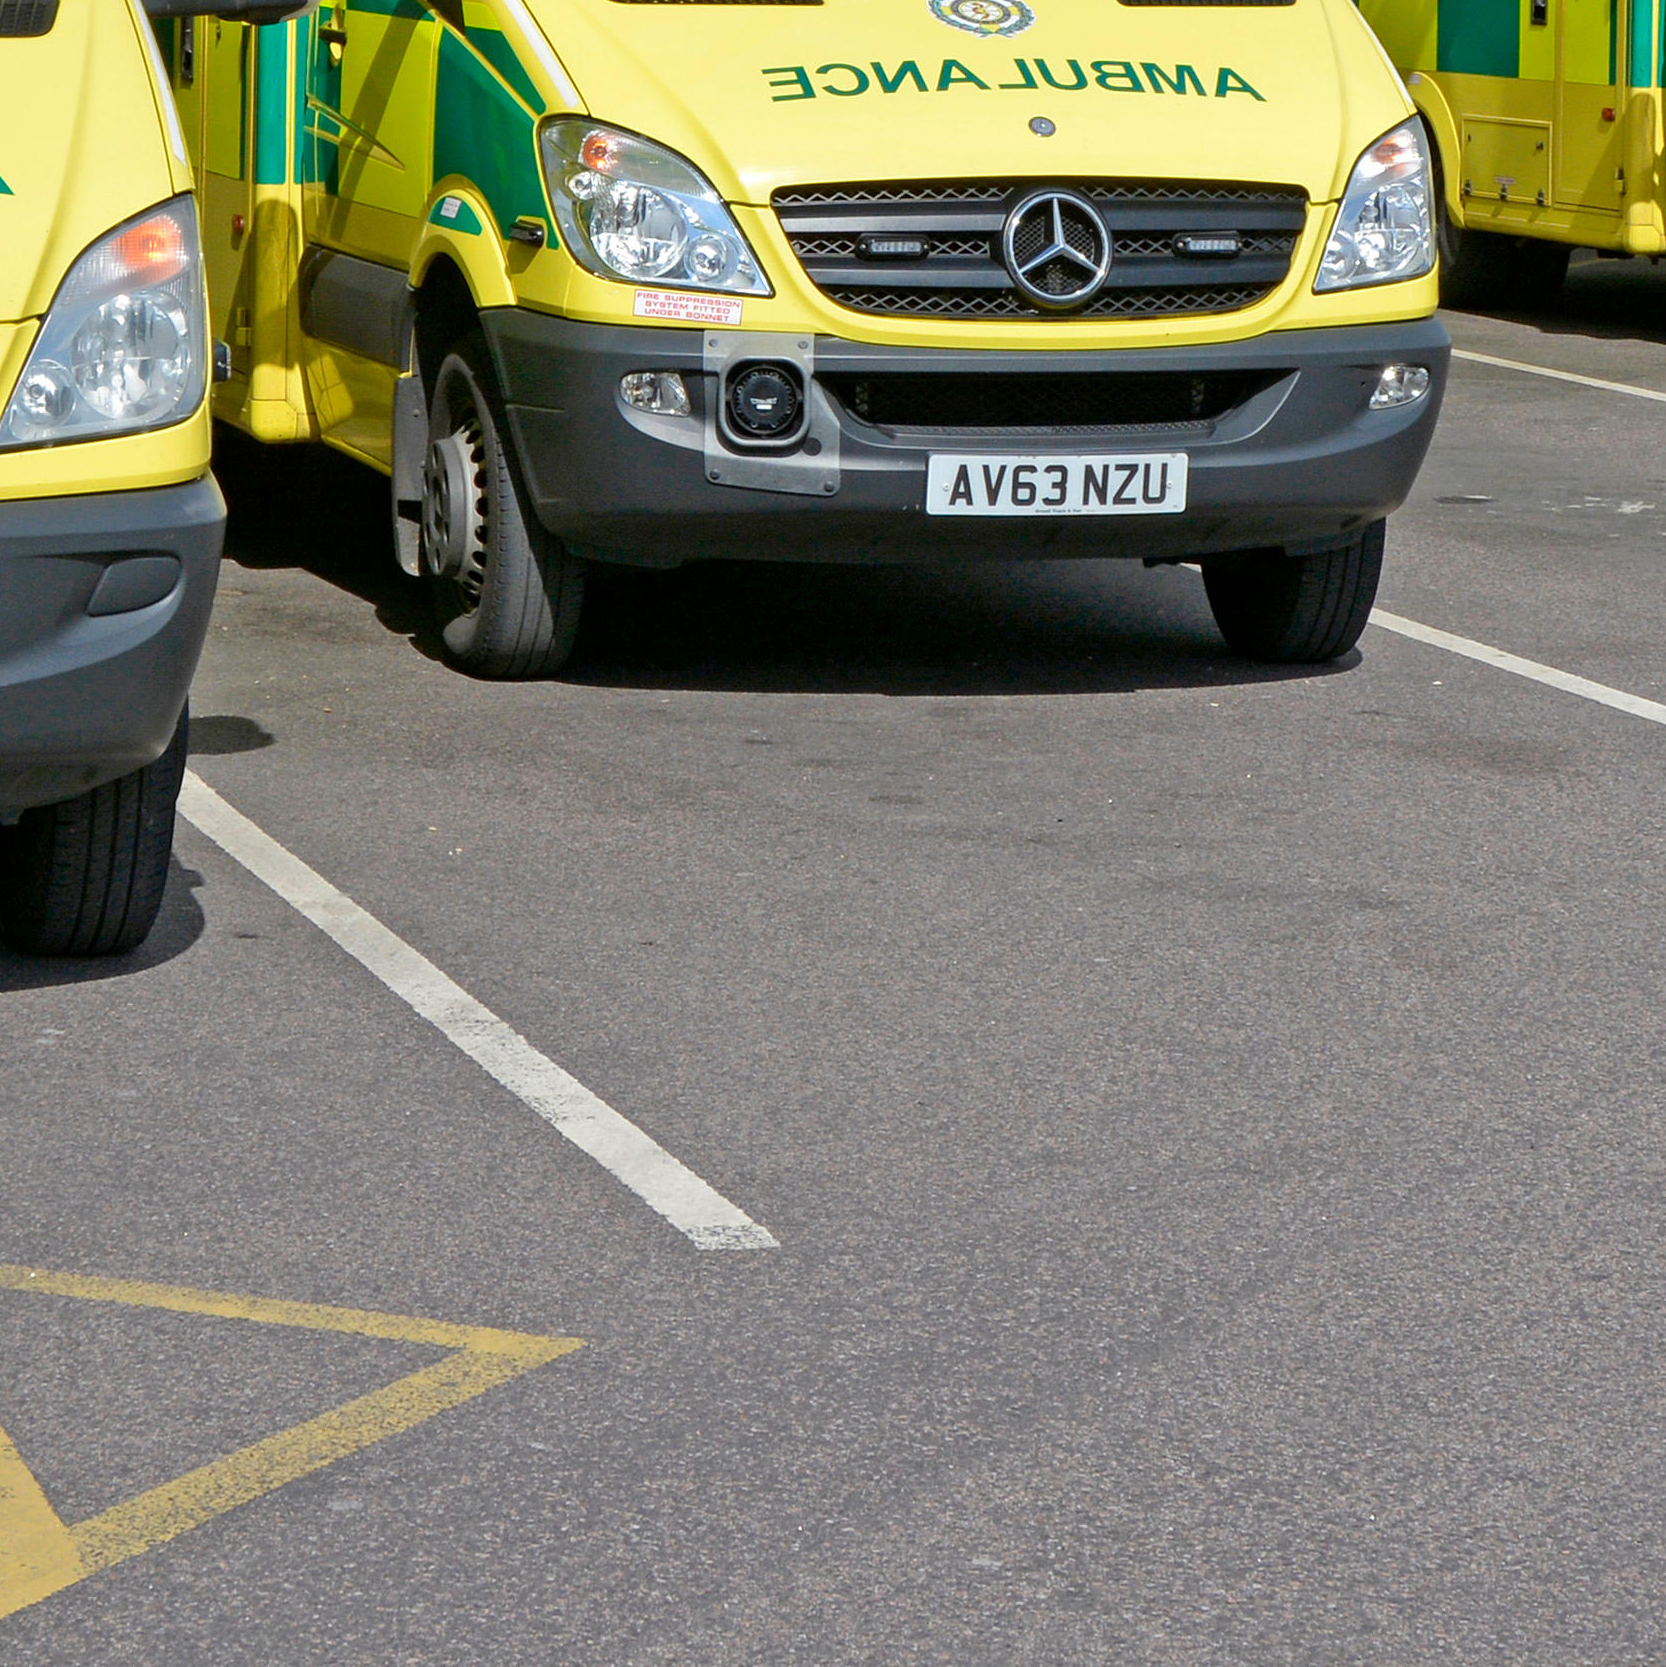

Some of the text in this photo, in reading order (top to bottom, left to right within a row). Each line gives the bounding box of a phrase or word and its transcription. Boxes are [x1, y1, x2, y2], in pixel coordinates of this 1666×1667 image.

[637, 292, 740, 309] FIRE SUPPRESSION
[645, 300, 731, 315] SYSTEM FITTED
[644, 307, 730, 322] UNDER BONNET
[948, 462, 1169, 507] AV63 NZU
